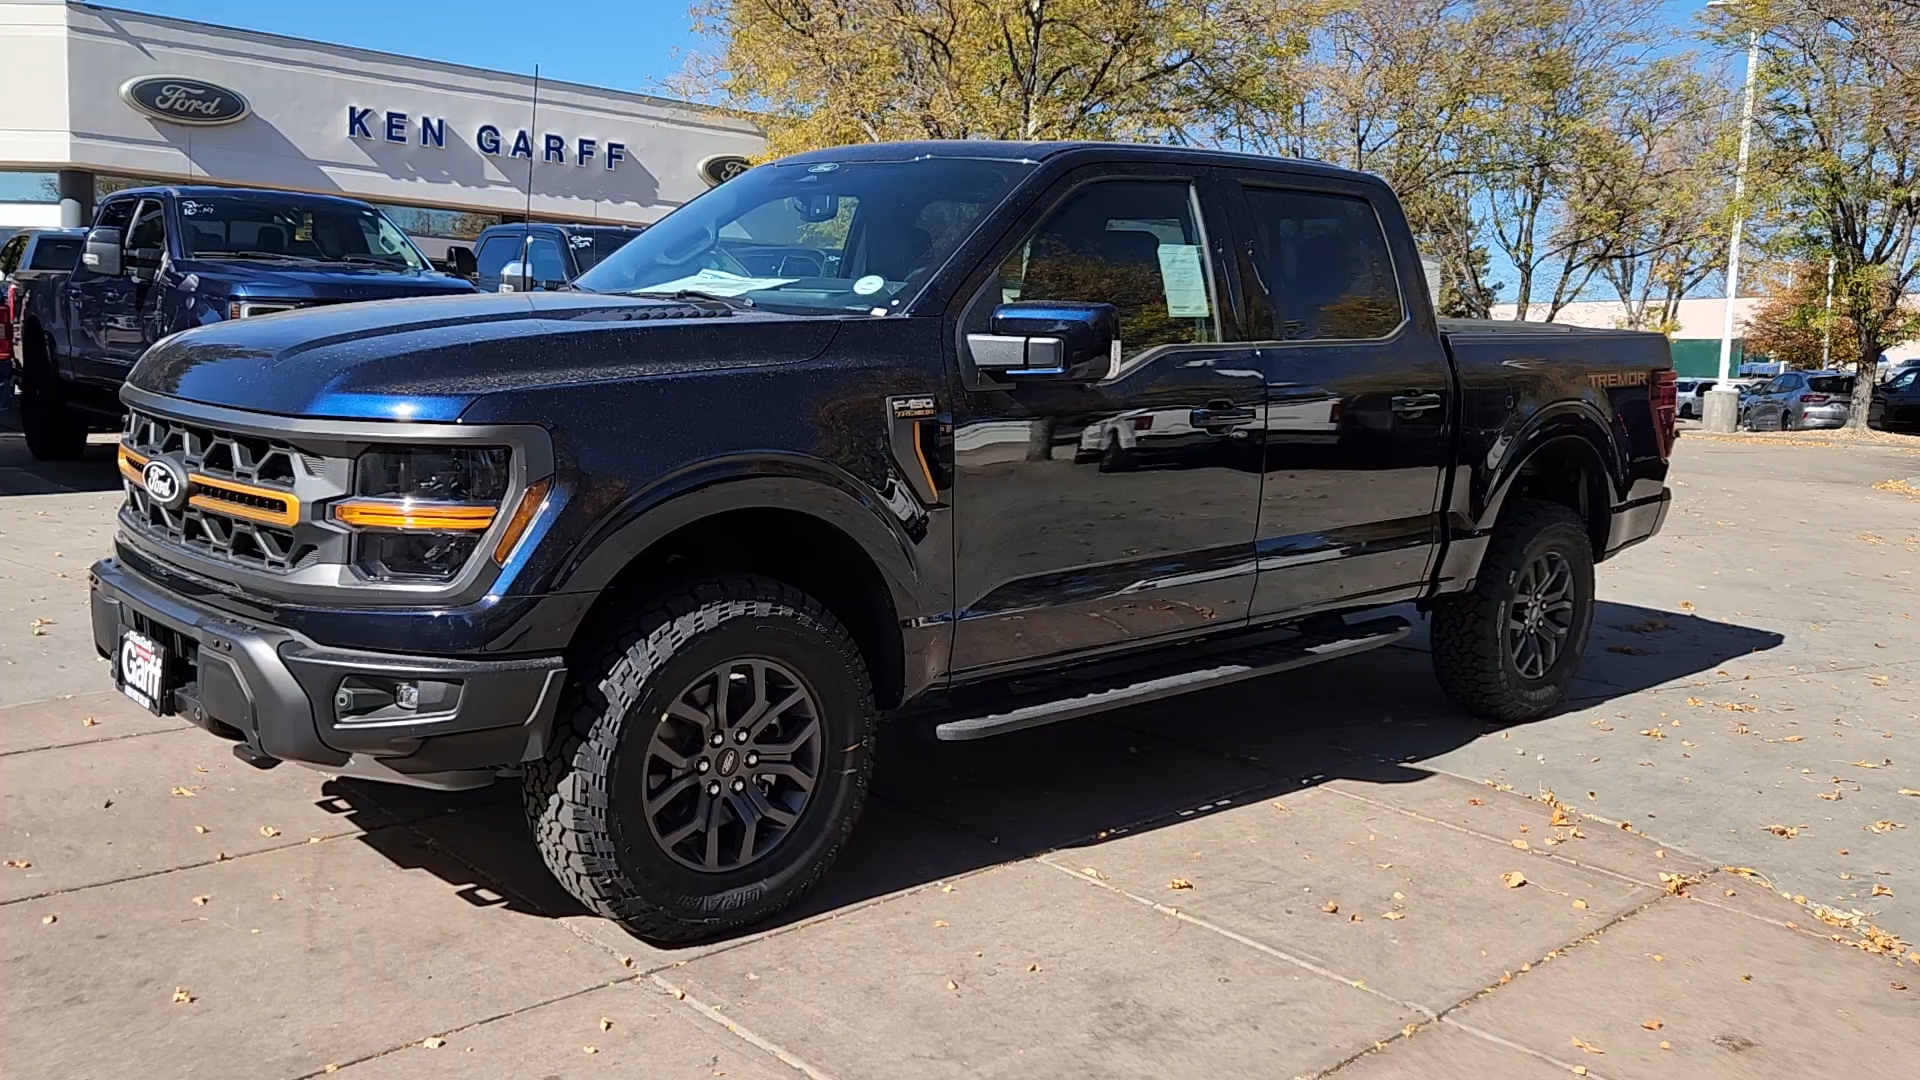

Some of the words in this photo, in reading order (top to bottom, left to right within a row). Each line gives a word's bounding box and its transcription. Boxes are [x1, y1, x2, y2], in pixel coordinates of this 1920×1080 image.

[155, 84, 221, 115] Ford
[347, 104, 447, 149] KEN
[475, 123, 626, 172] GARFF
[1587, 372, 1648, 388] TREMOR
[892, 398, 935, 410] F-150
[895, 409, 935, 418] TREMOR
[148, 465, 171, 497] Ford
[122, 640, 162, 701] Garff
